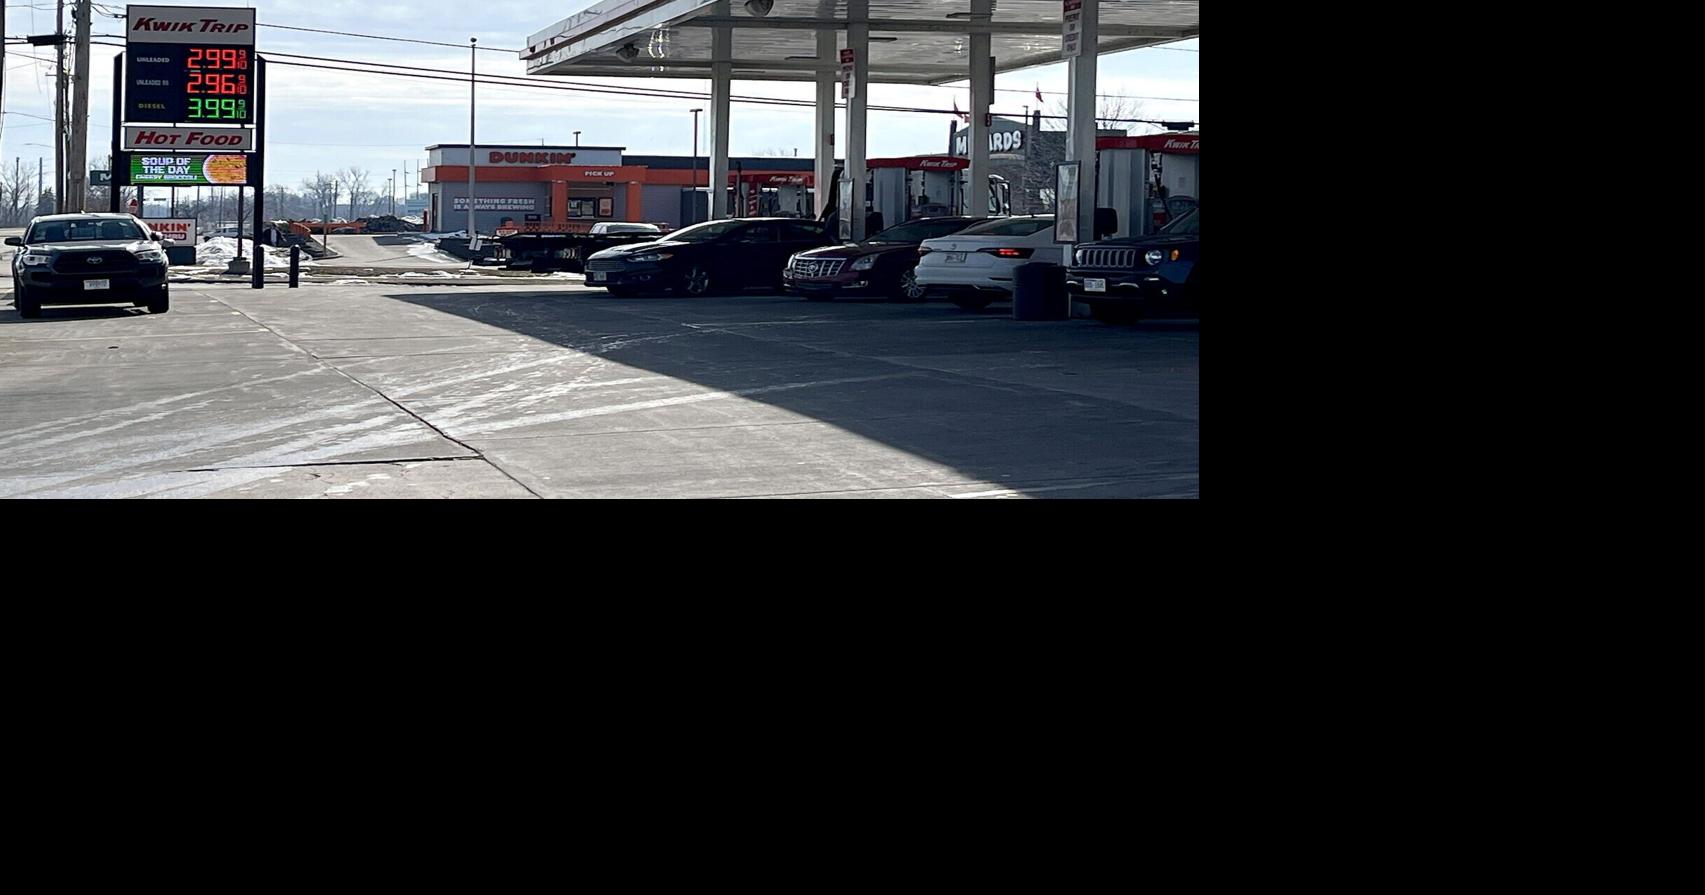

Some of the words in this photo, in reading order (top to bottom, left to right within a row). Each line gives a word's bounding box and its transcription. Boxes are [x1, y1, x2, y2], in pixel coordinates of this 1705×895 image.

[187, 48, 237, 69] 2.99
[187, 73, 236, 94] 2.96
[187, 98, 236, 119] 3.99
[134, 131, 182, 145] HOT
[184, 131, 243, 145] FOOD
[956, 130, 1021, 155] MRDS
[141, 157, 174, 167] SOUP
[176, 157, 192, 166] OF
[142, 165, 165, 174] THE
[168, 165, 191, 174] DAY
